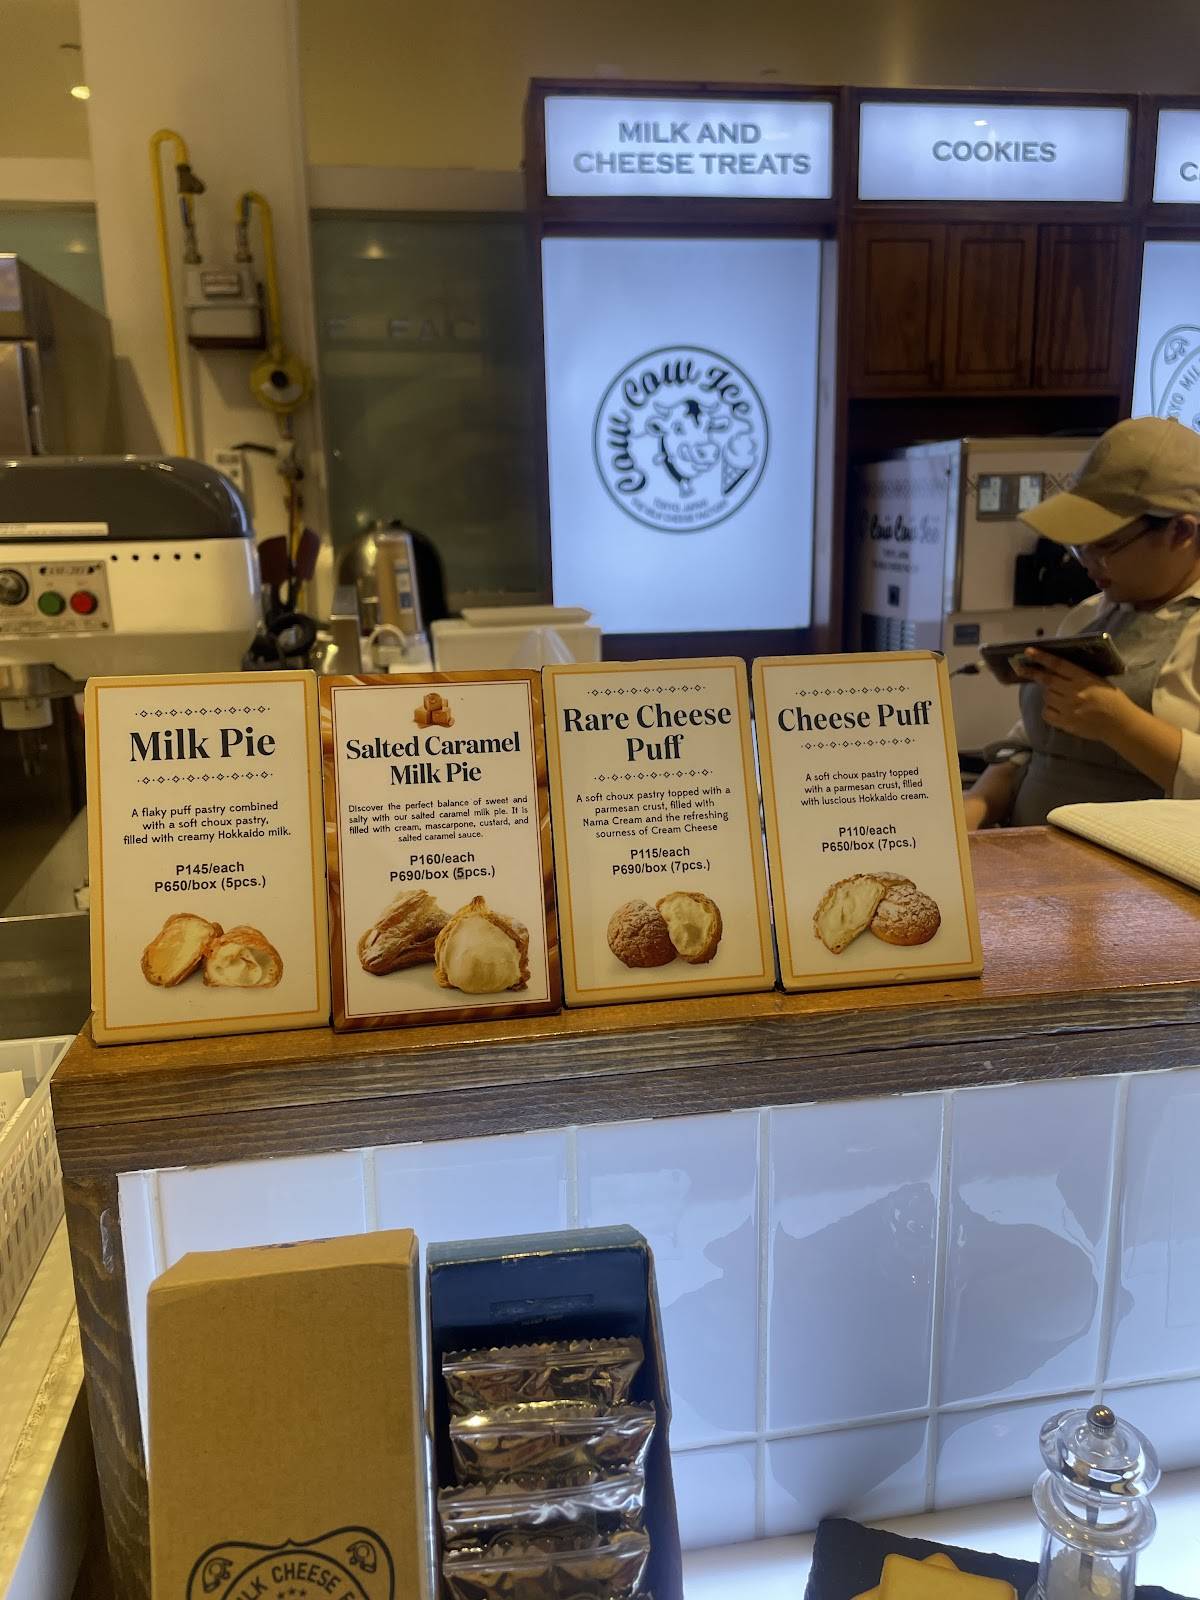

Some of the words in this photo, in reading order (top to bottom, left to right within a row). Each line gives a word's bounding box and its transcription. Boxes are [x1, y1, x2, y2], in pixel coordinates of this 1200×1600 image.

[618, 121, 690, 143] MILK
[696, 122, 761, 144] AND
[932, 140, 1057, 162] COOKIES
[573, 152, 695, 174] CHEESE
[698, 153, 812, 175] TREATS
[563, 708, 630, 732] Rare
[636, 704, 732, 729] Cheese
[778, 706, 870, 732] Cheese
[877, 700, 932, 727] Puff
[129, 728, 210, 762] Milk
[220, 726, 276, 758] Pie
[346, 736, 420, 760] Salted
[425, 732, 521, 756] Caramel
[626, 734, 684, 761] Puff
[391, 763, 441, 785] Milk
[447, 761, 482, 782] Pie
[814, 772, 830, 781] soft
[833, 771, 858, 780] choux
[862, 770, 887, 779] pastry
[889, 768, 919, 777] topped
[585, 794, 603, 802] soft
[606, 792, 634, 801] choux
[637, 791, 665, 801] pastry
[668, 788, 700, 798] topped
[702, 786, 722, 795] with
[804, 786, 823, 794] with
[834, 784, 875, 794] parmesan
[878, 782, 901, 790] crust,
[903, 780, 923, 788] filled
[348, 804, 383, 812] Discover
[405, 801, 434, 810] perfect
[437, 799, 469, 808] balance
[801, 798, 820, 806] with
[822, 796, 856, 805] luscious
[859, 794, 898, 803] Hokkaido
[901, 793, 929, 801] cream.
[131, 809, 138, 817] A
[142, 807, 167, 818] flaky
[171, 805, 191, 818] puff
[195, 805, 226, 816] pastry
[229, 801, 278, 812] combined
[595, 806, 640, 816] parmesan
[643, 803, 668, 811] crust,
[670, 801, 692, 809] filled
[695, 800, 715, 808] with
[143, 820, 165, 830] with
[179, 818, 198, 828] soft
[201, 818, 232, 827] choux
[236, 816, 269, 827] pastry,
[349, 815, 368, 825] salty
[372, 814, 390, 822] with
[394, 813, 407, 821] our
[411, 811, 435, 820] salted
[439, 810, 470, 818] caramel
[474, 808, 490, 816] milk
[493, 808, 508, 816] pie.
[583, 818, 609, 827] Nama
[612, 817, 643, 825] Cream
[645, 815, 663, 823] and
[666, 813, 681, 821] the
[683, 811, 729, 821] refreshing
[349, 826, 369, 834] filled
[372, 825, 391, 833] with
[394, 824, 421, 832] cream,
[425, 821, 476, 831] mascarpone,
[479, 818, 510, 827] custard,
[596, 829, 636, 838] sourness
[639, 827, 648, 835] of
[651, 826, 681, 835] Cream
[684, 824, 718, 832] Cheese
[839, 824, 896, 837] P110/each
[123, 835, 148, 845] filled
[152, 834, 174, 843] with
[177, 833, 215, 843] creamy
[218, 828, 265, 839] Hokkaido
[268, 827, 291, 837] milk.
[398, 833, 422, 842] salted
[425, 831, 456, 840] caramel
[630, 846, 690, 859] P115/each
[822, 841, 874, 852] P650/box
[878, 837, 916, 851] (7pcs.)
[410, 852, 475, 865] P160/each
[176, 861, 245, 875] P145/each
[390, 868, 449, 881] P690/box
[453, 866, 495, 880] (5pcs.)
[613, 862, 667, 875] P690/box
[671, 859, 710, 873] (7pcs.)
[155, 878, 217, 892] P650/box
[221, 875, 266, 891] (5pcs.)
[271, 1562, 341, 1594] CHEESE
